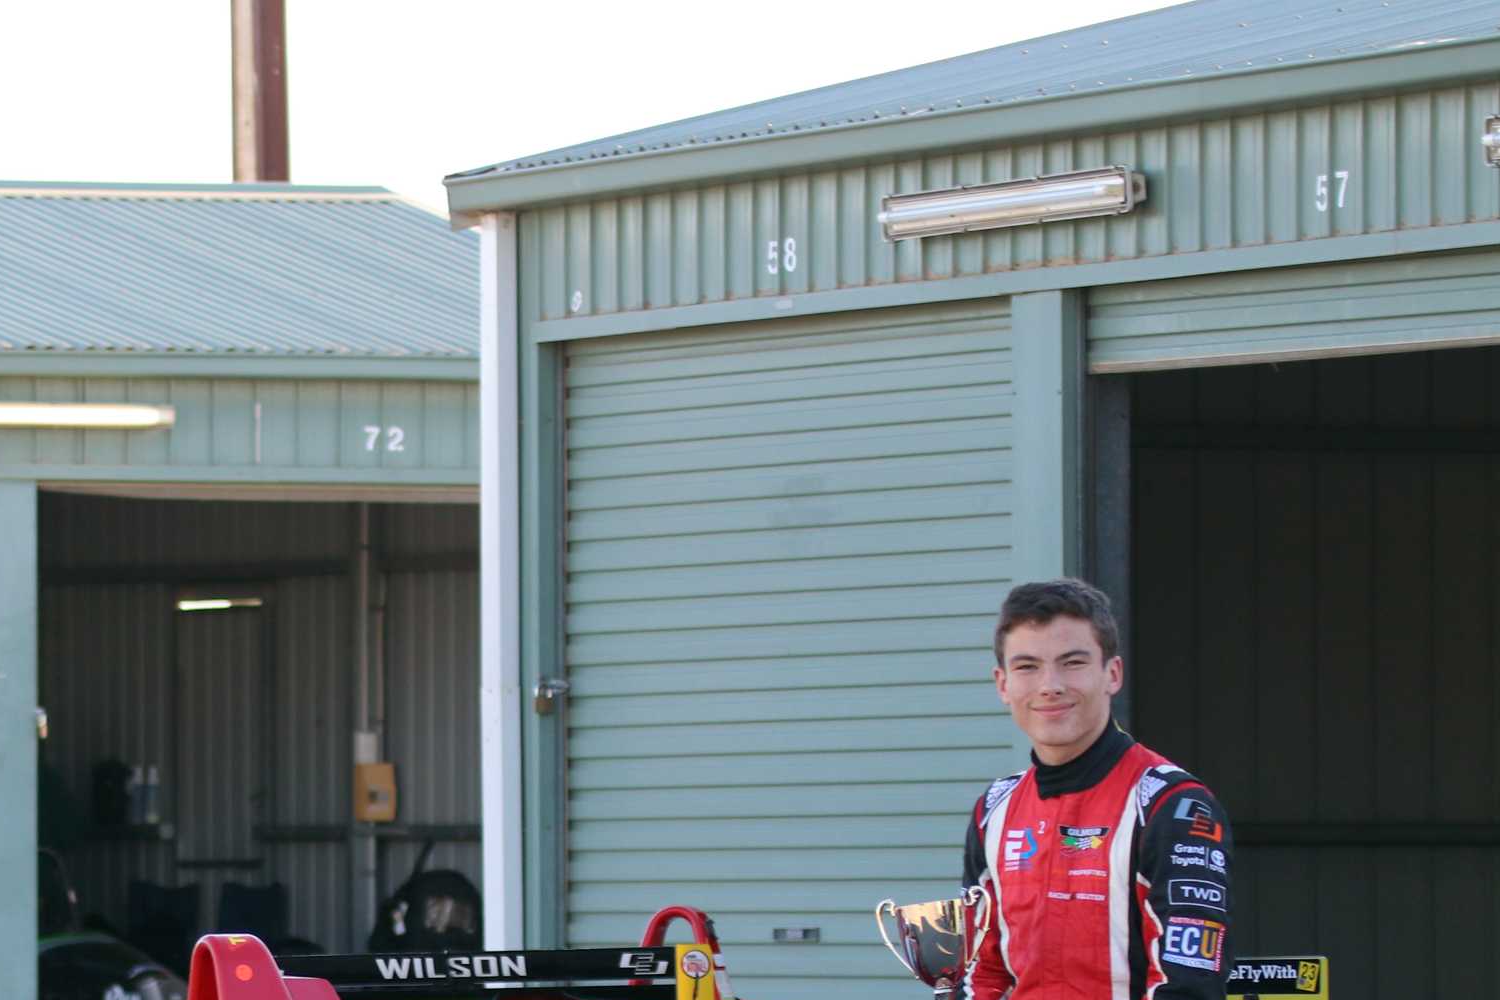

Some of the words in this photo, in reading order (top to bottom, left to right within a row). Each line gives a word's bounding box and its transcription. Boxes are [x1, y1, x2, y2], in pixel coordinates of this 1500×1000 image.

[1315, 171, 1348, 212] 57
[767, 237, 797, 275] 58
[363, 425, 404, 451] 72
[1174, 843, 1205, 855] Grand
[1170, 855, 1205, 867] Toyota
[1180, 885, 1221, 902] TWD
[1164, 925, 1218, 959] ECU
[375, 955, 527, 980] WILSON
[1228, 964, 1298, 983] eFlyWith
[1300, 963, 1316, 980] 23
